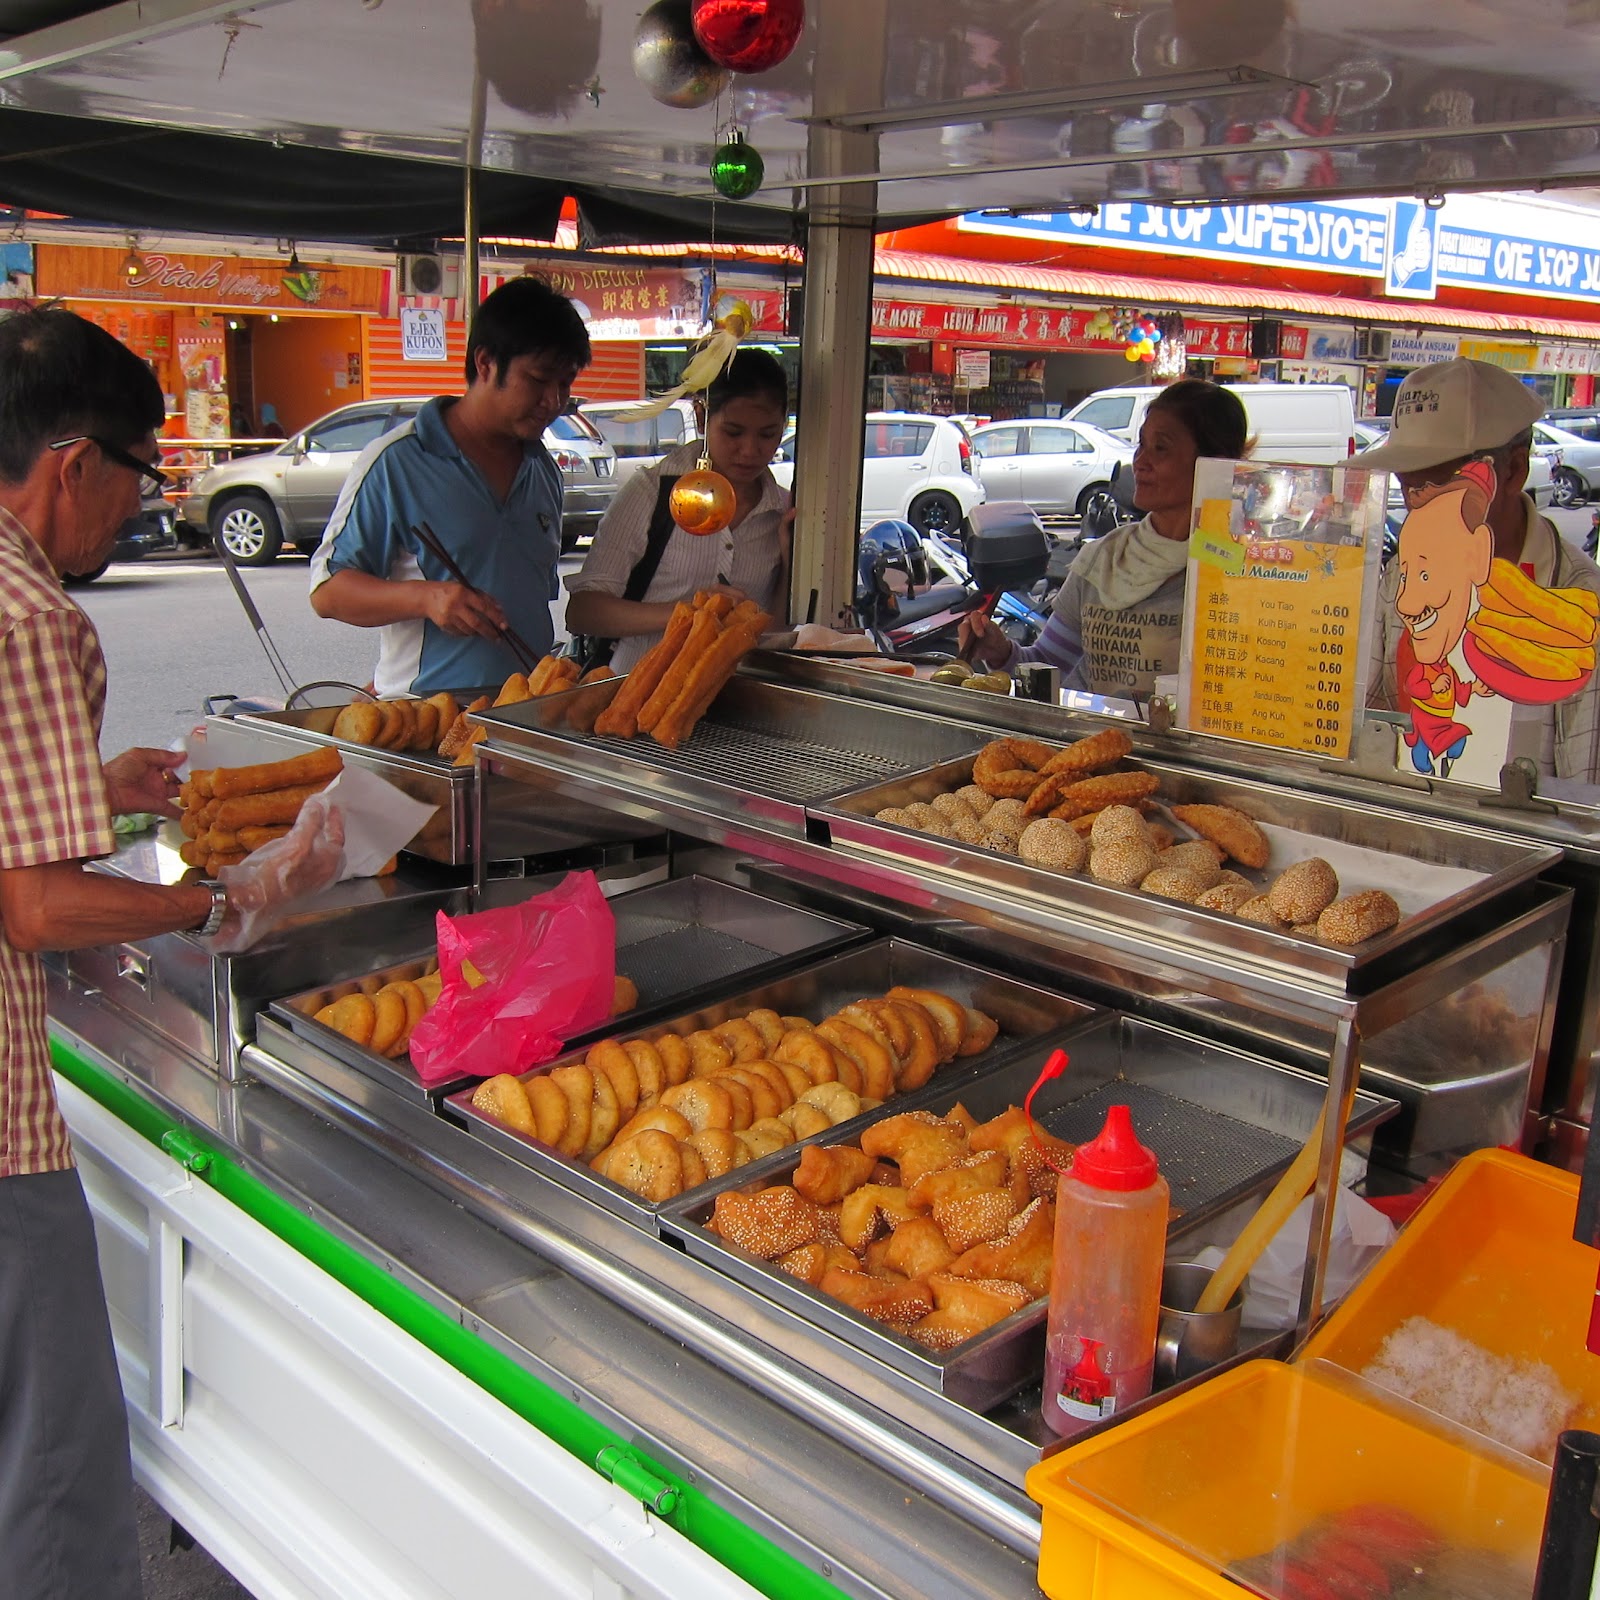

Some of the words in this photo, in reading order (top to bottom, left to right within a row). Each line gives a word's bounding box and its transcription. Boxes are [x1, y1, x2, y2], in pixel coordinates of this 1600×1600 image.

[1216, 202, 1387, 265] SUPERSTORE
[1494, 240, 1534, 282] ONE
[1535, 246, 1579, 288] STOP
[218, 273, 280, 303] Village
[410, 322, 437, 336] EJEN
[889, 309, 922, 328] MORE
[943, 312, 976, 331] LEBIH
[977, 314, 1008, 333] JIMAT
[406, 335, 443, 349] KUPON
[1391, 339, 1423, 351] BAYARAN
[1425, 340, 1456, 352] ANSURAN
[1391, 352, 1414, 362] MUDAH
[1249, 566, 1309, 582] Maharani
[1260, 600, 1275, 609] You
[1278, 602, 1294, 611] Tiao
[1323, 604, 1349, 618] 0.60
[1116, 611, 1180, 627] MANABE
[1258, 618, 1276, 628] Kuih
[1322, 624, 1344, 636] 0.60
[1092, 622, 1142, 640] HIYAMA
[1091, 637, 1141, 656] HIYAMA
[1257, 637, 1286, 649] Kosong
[1321, 642, 1343, 655] 0.60
[1255, 655, 1285, 667] Kacang
[1319, 661, 1342, 674] 0.60
[1254, 672, 1275, 683] Pulut
[1318, 680, 1340, 693] 0.70
[1317, 699, 1339, 712] 0.60
[1252, 709, 1268, 720] Ang
[1270, 710, 1286, 721] Kuh
[1317, 718, 1339, 731] 0.80
[1251, 726, 1266, 736] Fan
[1268, 729, 1285, 739] Gao
[1315, 734, 1337, 748] 0.90
